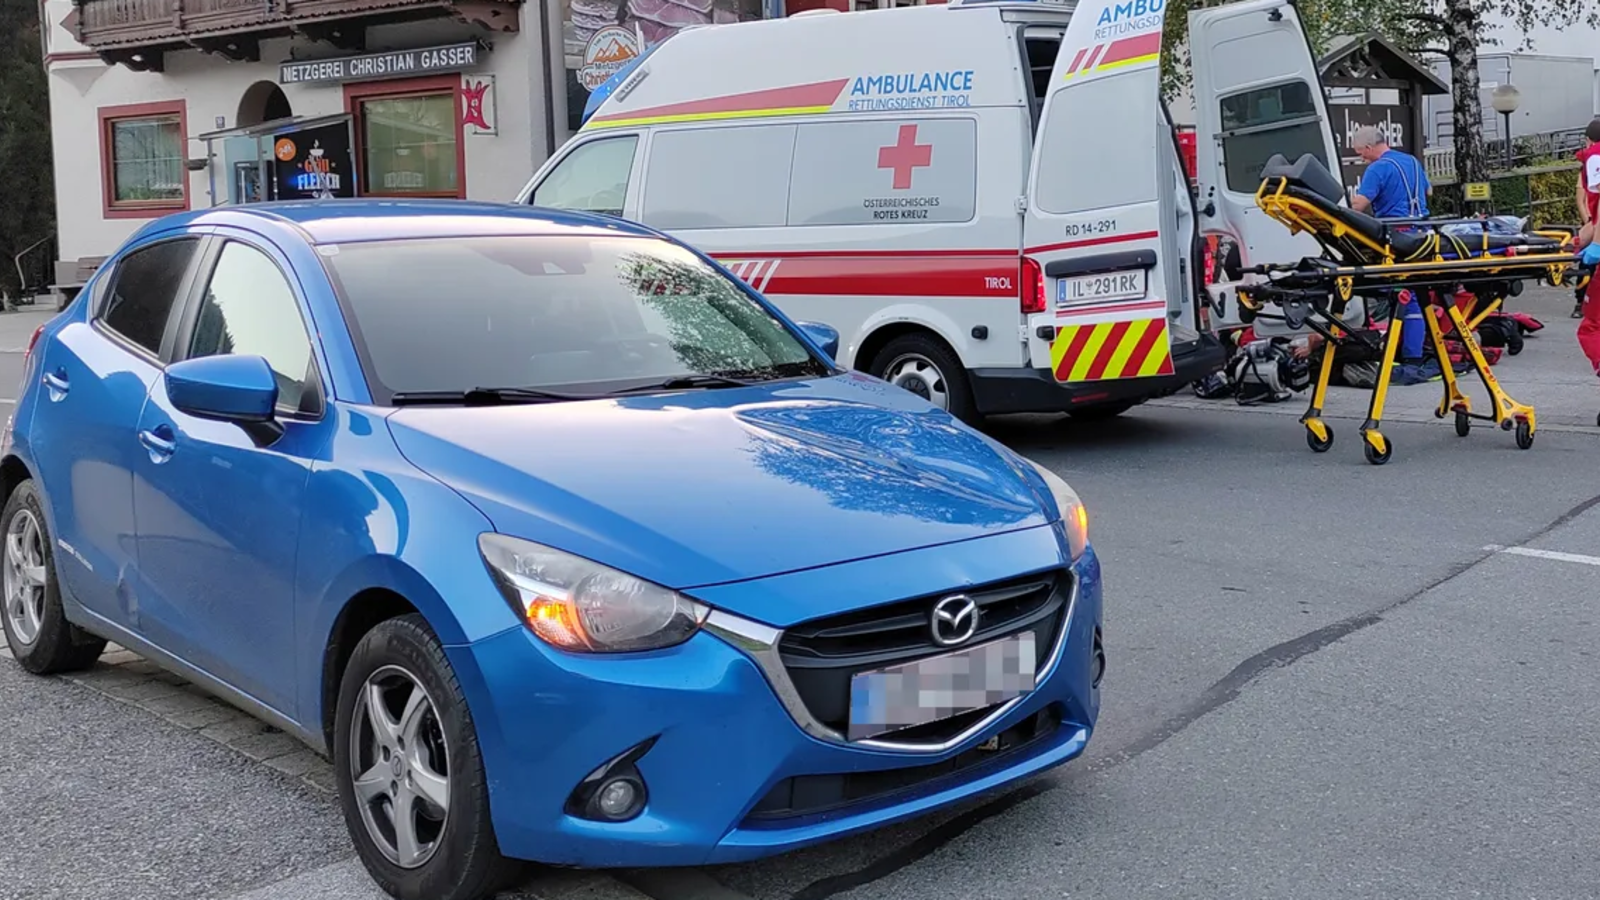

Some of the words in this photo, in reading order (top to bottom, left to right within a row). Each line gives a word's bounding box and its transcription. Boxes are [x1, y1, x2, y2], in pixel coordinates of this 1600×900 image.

[1097, 0, 1163, 26] AMBU
[350, 53, 414, 75] CHRISTIAN
[421, 47, 473, 68] GASSER
[850, 71, 974, 96] AMBULANCE
[848, 96, 937, 111] RETTUNGSDIENST
[941, 94, 971, 108] TIROL
[863, 197, 940, 208] ÖSTERREICHISCHES
[873, 210, 899, 219] ROTES
[901, 209, 928, 219] KREUZ
[1066, 225, 1079, 236] RD
[1081, 220, 1117, 234] 14-291
[985, 277, 1013, 289] TIROL
[1073, 281, 1085, 298] IL
